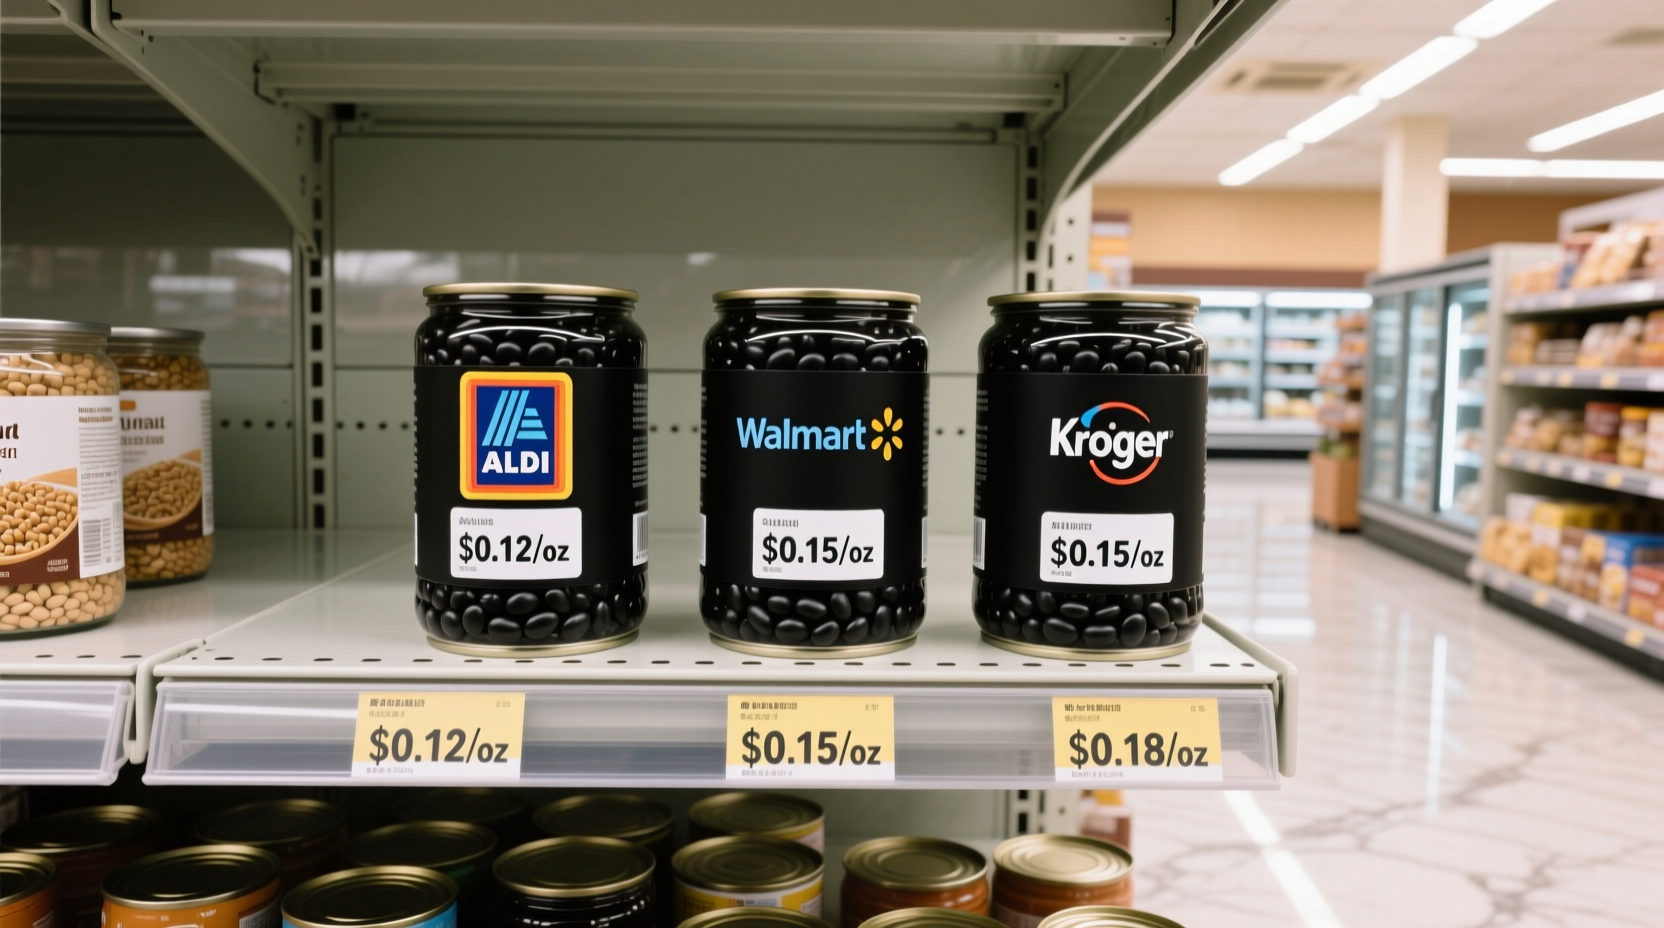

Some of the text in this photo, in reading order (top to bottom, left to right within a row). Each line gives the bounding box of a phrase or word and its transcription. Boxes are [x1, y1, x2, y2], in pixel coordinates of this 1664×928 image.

[736, 417, 867, 450] Walmart
[1050, 417, 1169, 470] Kroger
[481, 450, 550, 474] ALDI
[459, 532, 570, 564] $0.12/oz
[762, 532, 874, 566] $0.15/oz
[1051, 536, 1164, 569] $0.15/oz
[369, 725, 509, 766] $0.12/oz
[742, 727, 882, 769] $0.15/oz
[1069, 729, 1209, 769] $0.18/oz
